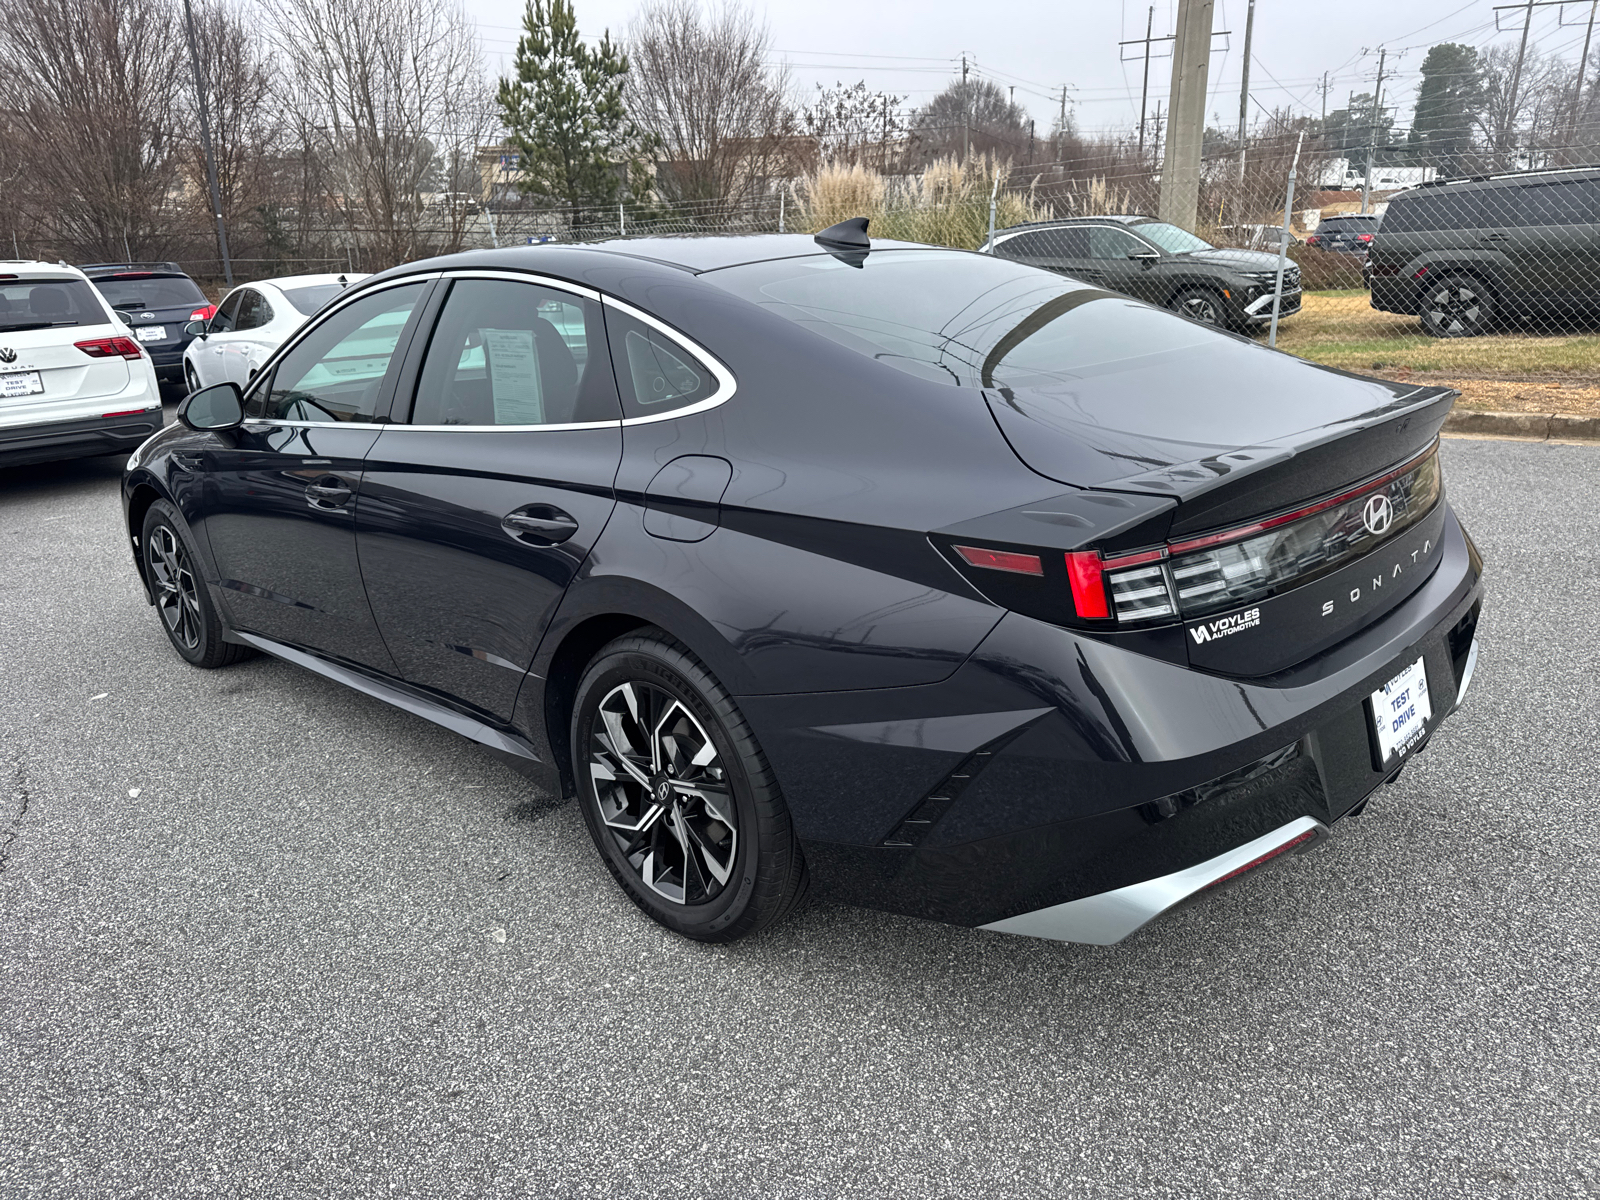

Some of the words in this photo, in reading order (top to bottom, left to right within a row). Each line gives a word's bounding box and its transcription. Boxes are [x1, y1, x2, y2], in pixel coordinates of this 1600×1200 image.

[1321, 539, 1432, 617] SONATA
[1209, 607, 1260, 632] VOYLES
[1212, 618, 1260, 640] AUTOMOTIVE
[643, 659, 713, 721] MICHELIN
[1391, 687, 1410, 712] TEST
[1392, 704, 1416, 733] DRIVE
[1407, 727, 1426, 748] VOYLES
